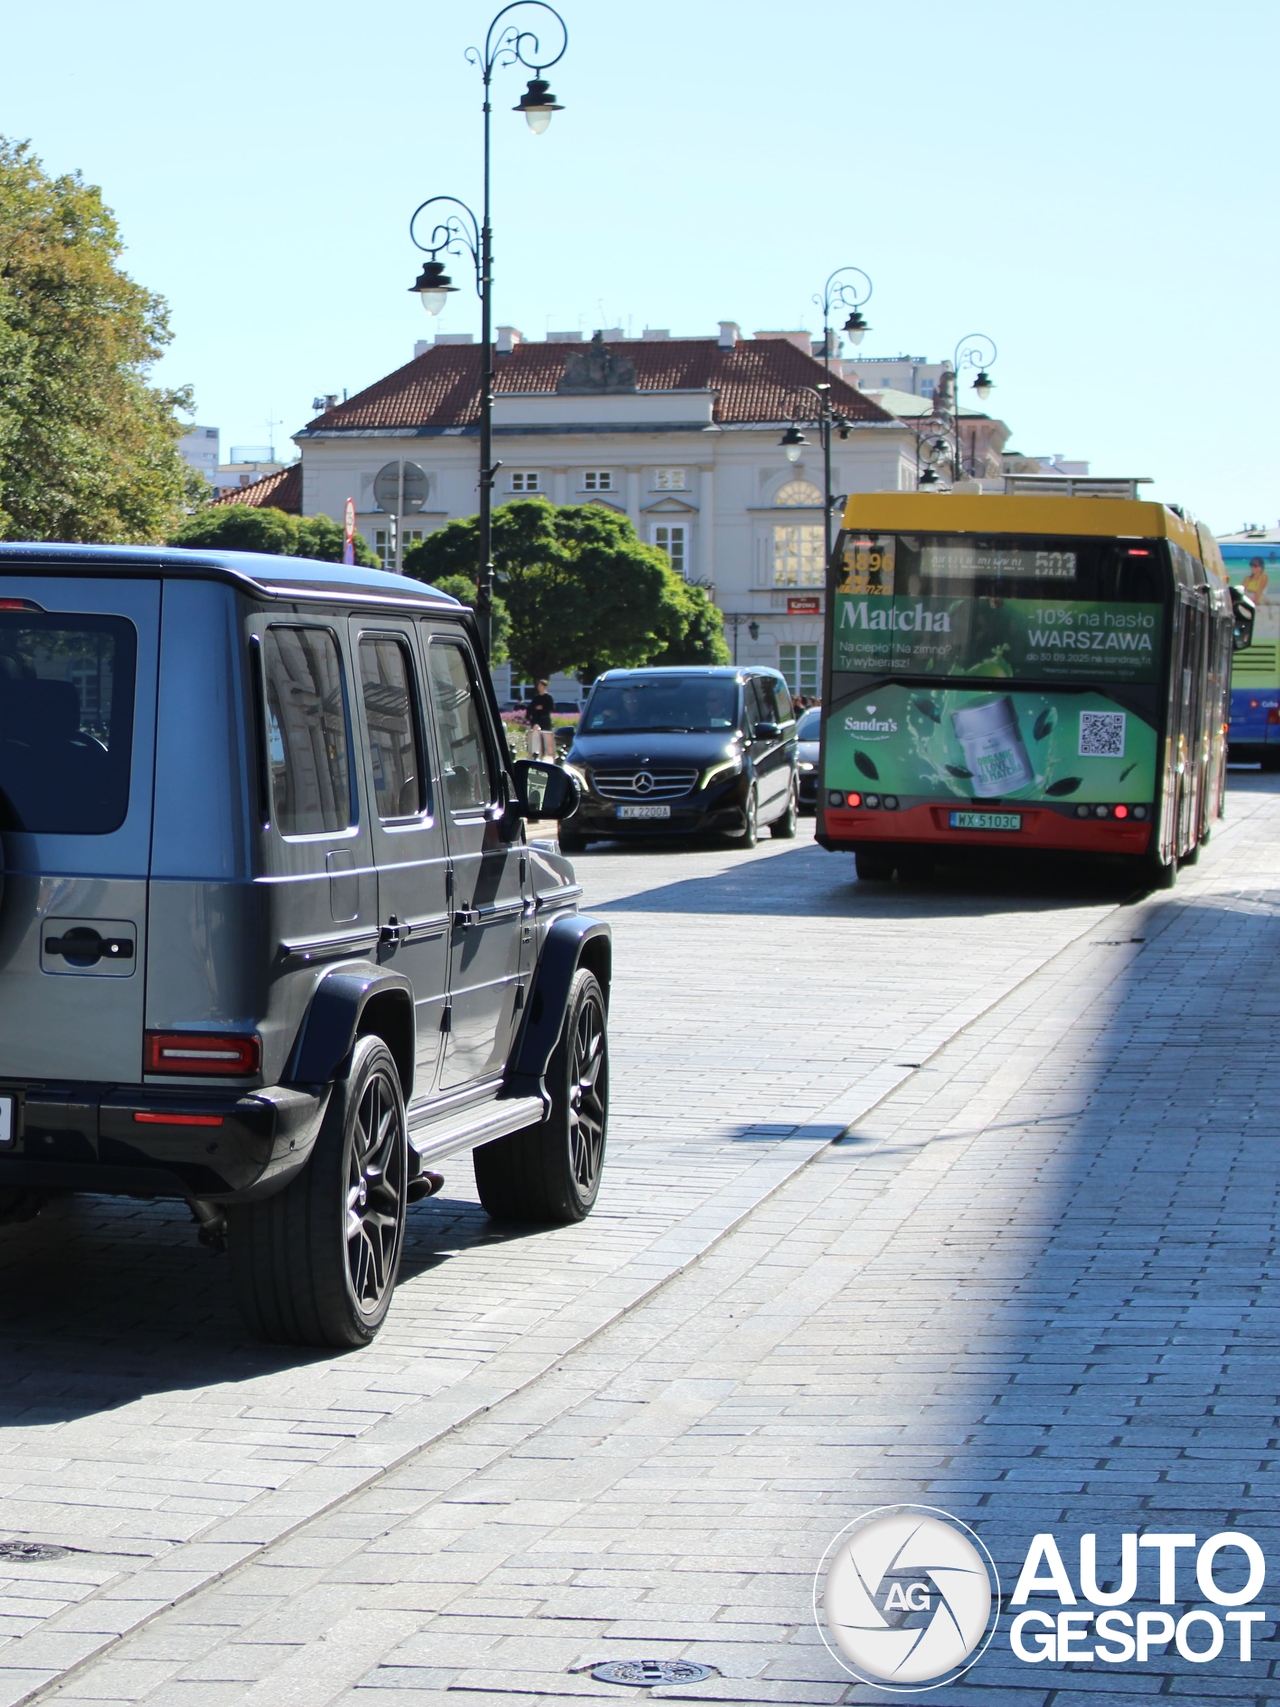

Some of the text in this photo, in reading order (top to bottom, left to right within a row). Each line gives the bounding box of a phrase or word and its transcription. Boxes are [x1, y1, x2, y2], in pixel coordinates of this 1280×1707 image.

[843, 553, 894, 572] 5896
[840, 601, 952, 632] Matcha
[1078, 613, 1100, 626] na
[1104, 612, 1154, 628] hasło
[1027, 630, 1152, 651] WARSZAWA
[840, 642, 853, 652] Na
[896, 644, 911, 654] Na
[913, 645, 952, 655] zimno?
[840, 656, 910, 669] Ty wybierasz!
[844, 717, 898, 732] Sandra's
[977, 748, 1014, 766] ORGANIC
[985, 760, 1008, 773] LOVE
[989, 763, 1023, 781] MATCHA
[623, 807, 636, 817] WX
[958, 814, 1018, 828] WX 5103C
